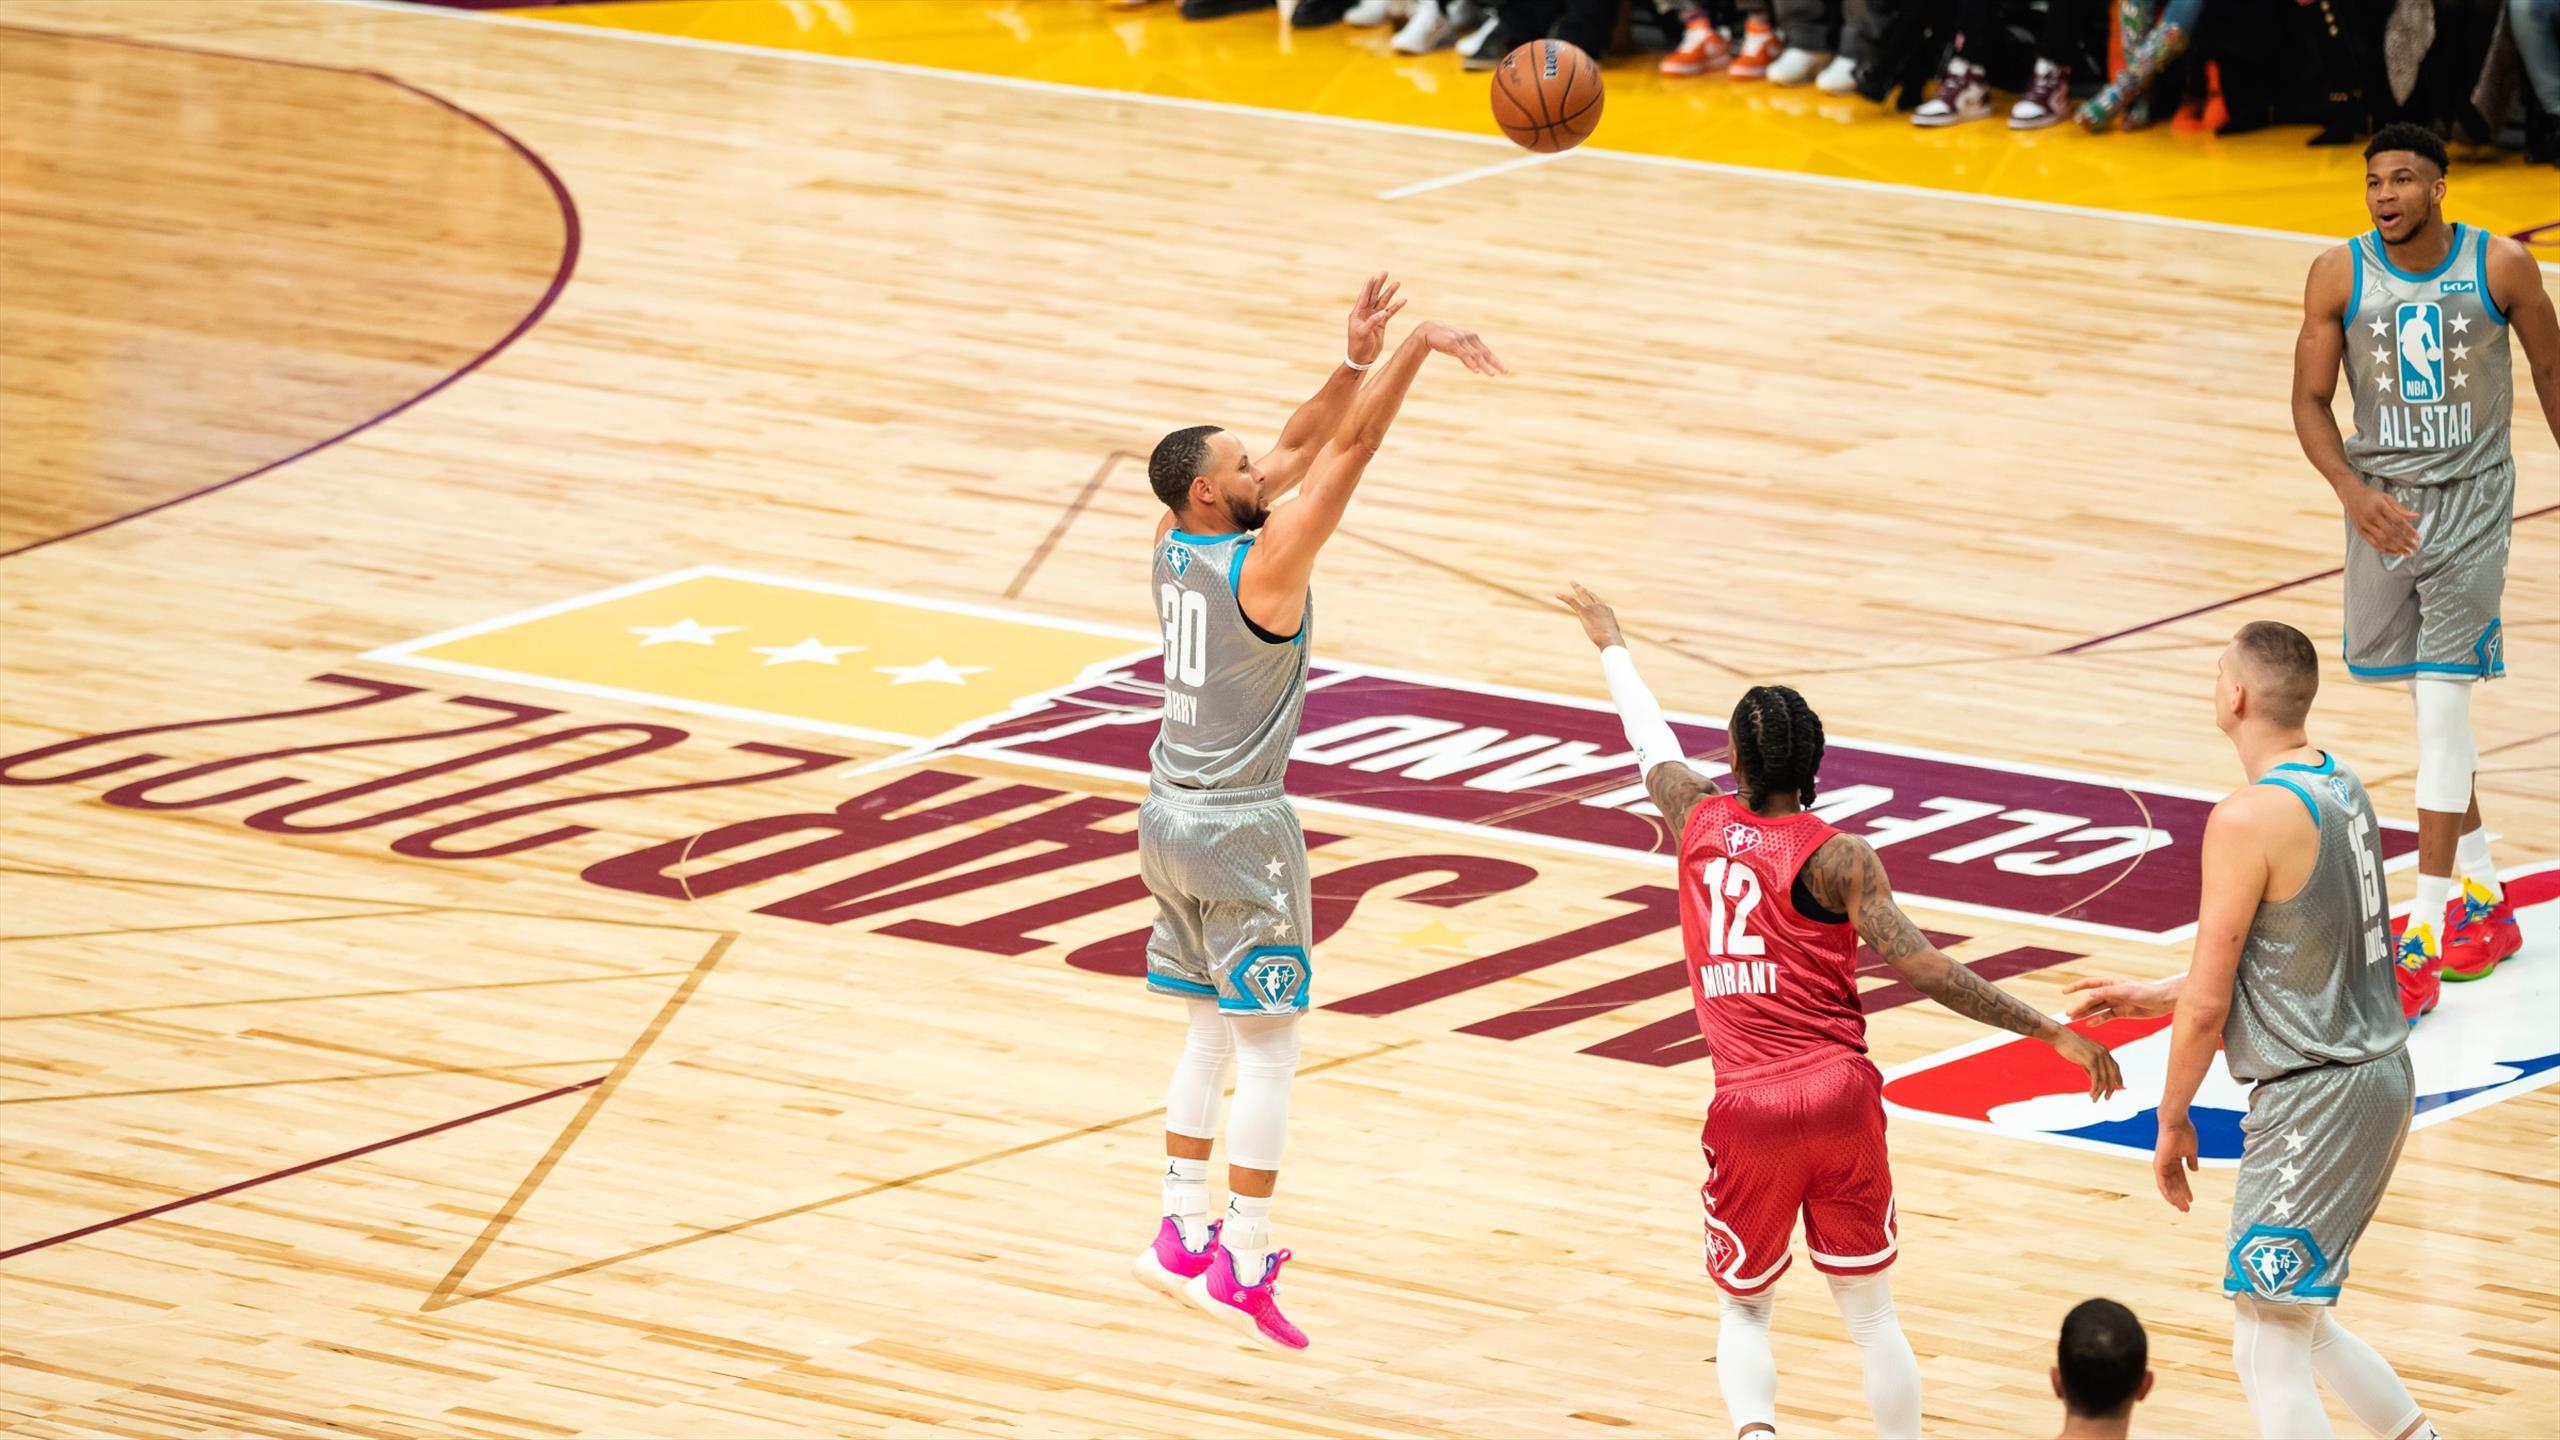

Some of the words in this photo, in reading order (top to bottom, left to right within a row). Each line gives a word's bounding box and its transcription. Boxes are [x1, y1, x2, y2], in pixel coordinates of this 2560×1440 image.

[2443, 282, 2473, 291] KIA
[2406, 381, 2428, 397] NBA
[2379, 401, 2472, 448] ALL-STAR
[1161, 584, 1206, 688] 30
[1164, 688, 1197, 727] URRY
[0, 674, 854, 859] 2022
[1288, 714, 2173, 876] CLELAND
[2347, 812, 2381, 922] 15
[1703, 857, 1765, 956] 12
[1700, 961, 1778, 999] MORANT
[2279, 1254, 2290, 1269] 75
